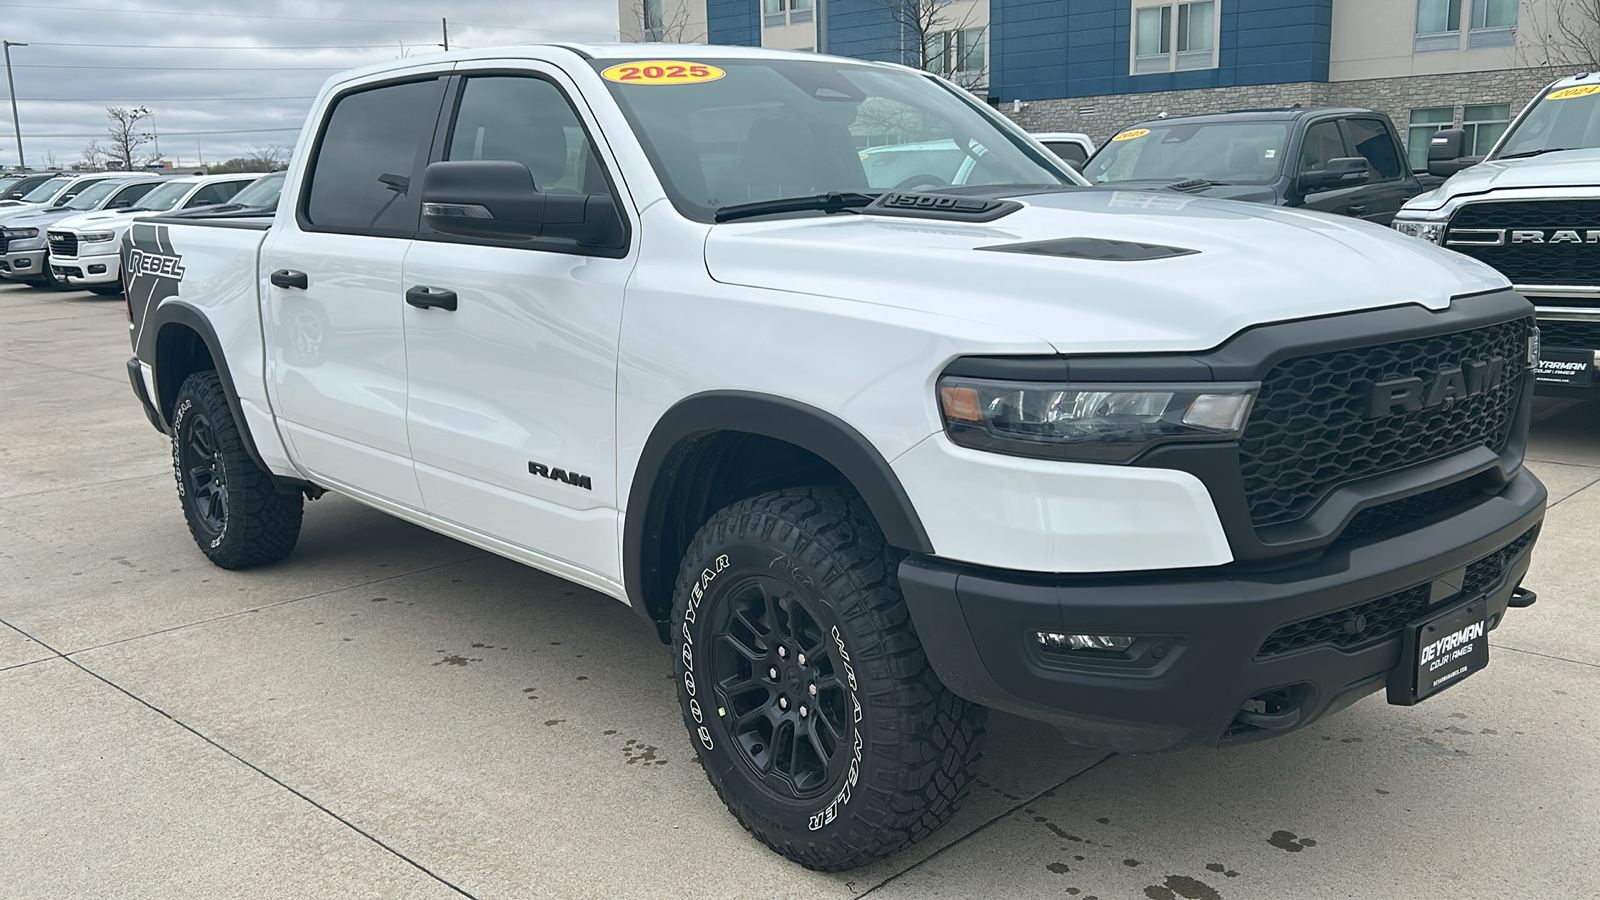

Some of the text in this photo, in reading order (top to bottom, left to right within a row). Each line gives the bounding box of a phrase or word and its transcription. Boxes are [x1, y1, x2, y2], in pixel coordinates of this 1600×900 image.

[619, 66, 711, 80] 2025
[884, 192, 957, 209] 1500
[128, 248, 186, 282] REBEL
[1539, 360, 1587, 371] YARMAN
[1369, 355, 1503, 419] RAM
[528, 460, 592, 491] RAM
[682, 554, 731, 751] GOODYEAR
[1420, 620, 1485, 666] DEYARMAN
[1451, 643, 1473, 660] AMES
[808, 625, 873, 831] WRANGLER
